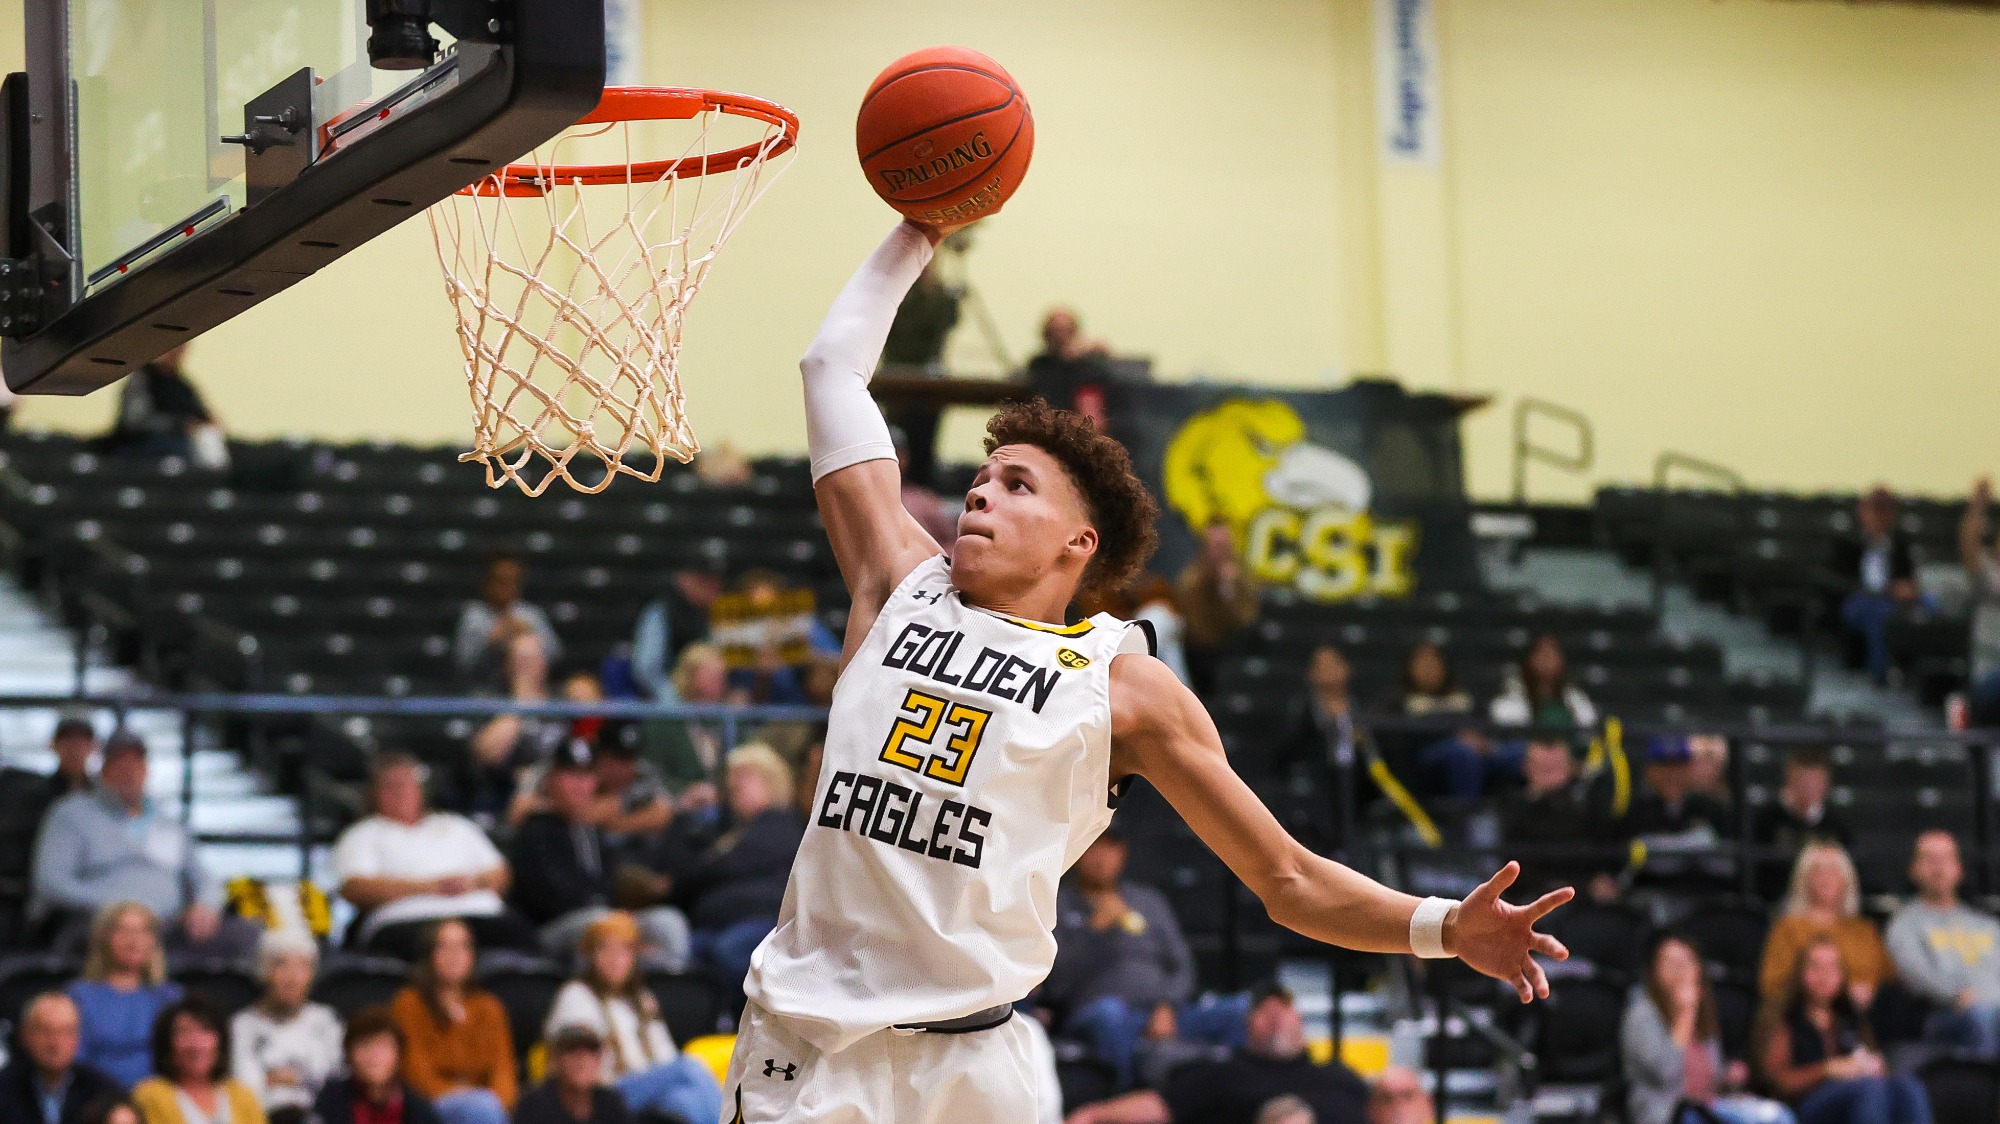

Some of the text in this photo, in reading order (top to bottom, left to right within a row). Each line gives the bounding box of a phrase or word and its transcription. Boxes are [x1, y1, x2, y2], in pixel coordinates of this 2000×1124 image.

[879, 131, 993, 193] SPALDING
[1249, 508, 1418, 599] CSI
[881, 622, 1062, 714] GOLDEN
[1059, 650, 1089, 668] BG
[878, 688, 993, 787] 23
[817, 771, 992, 869] EAGLES
